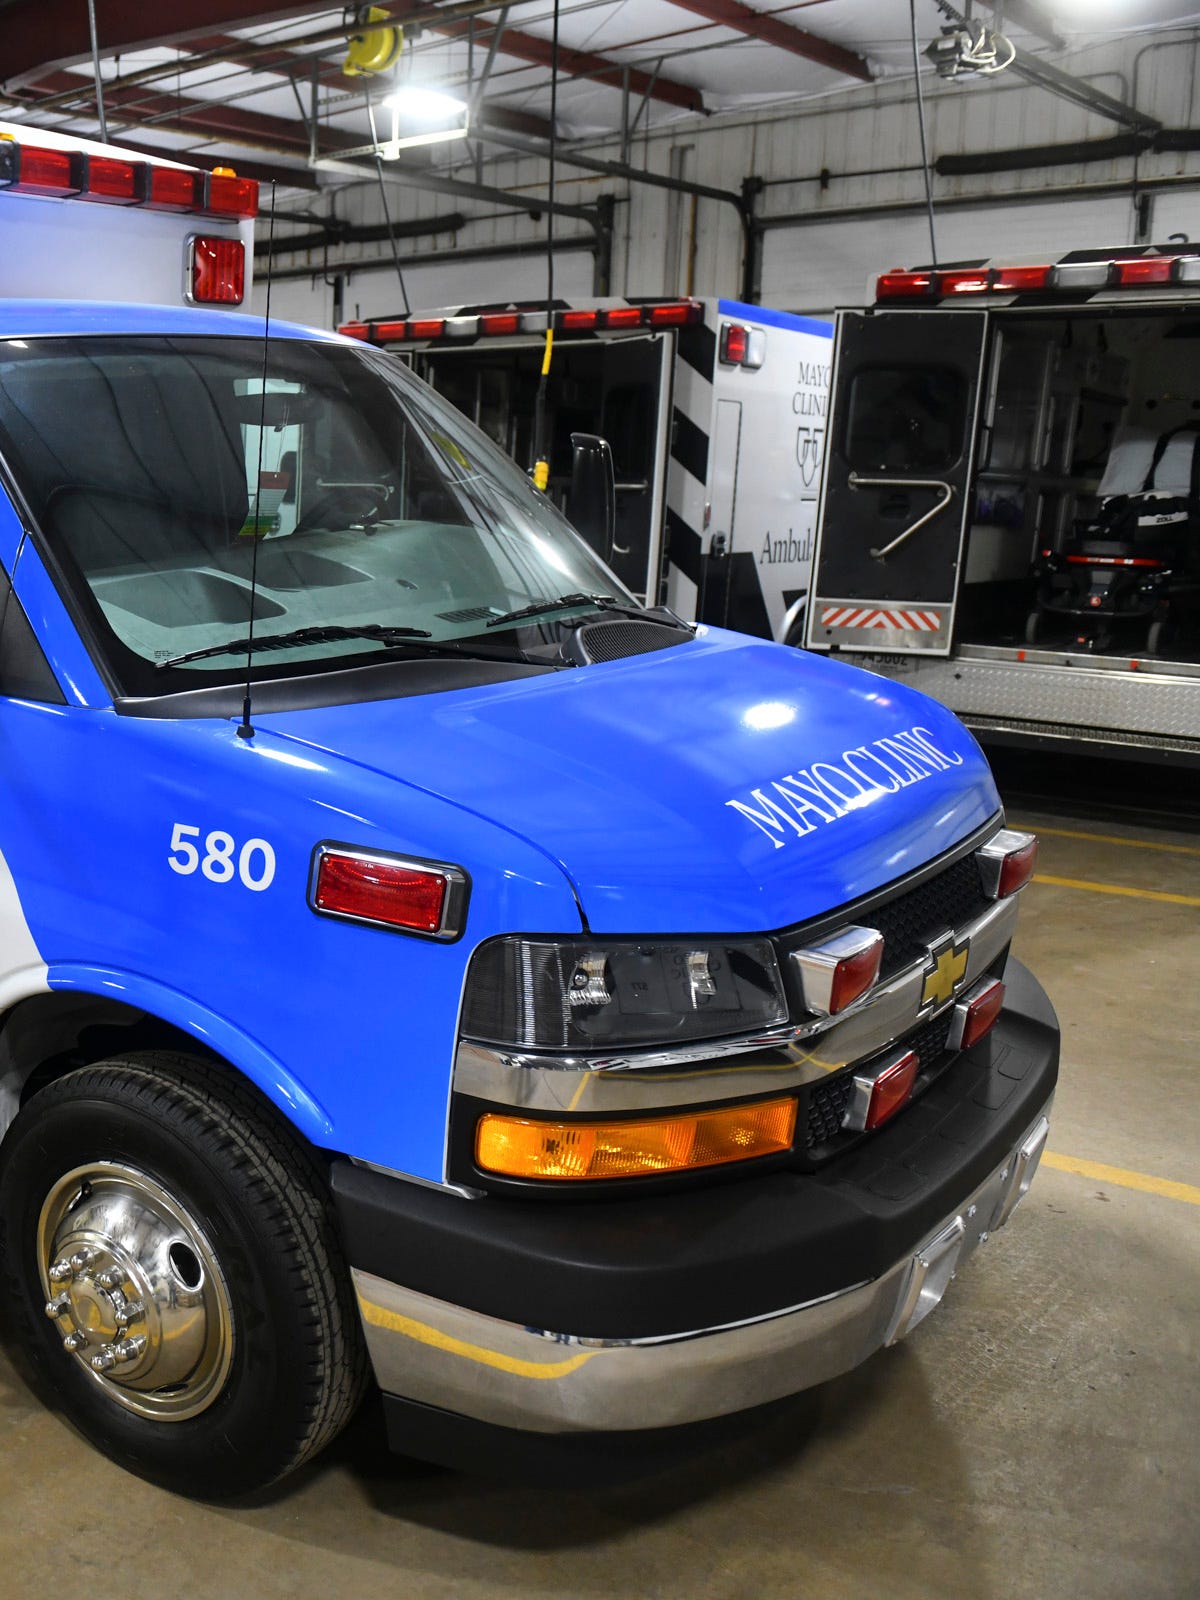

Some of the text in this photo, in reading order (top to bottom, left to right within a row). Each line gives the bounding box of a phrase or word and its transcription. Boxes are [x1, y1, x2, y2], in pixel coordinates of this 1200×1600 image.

[792, 391, 827, 417] CLINI
[759, 527, 813, 564] Ambul
[725, 726, 964, 849] MAYO CLINIC
[167, 822, 276, 892] 580
